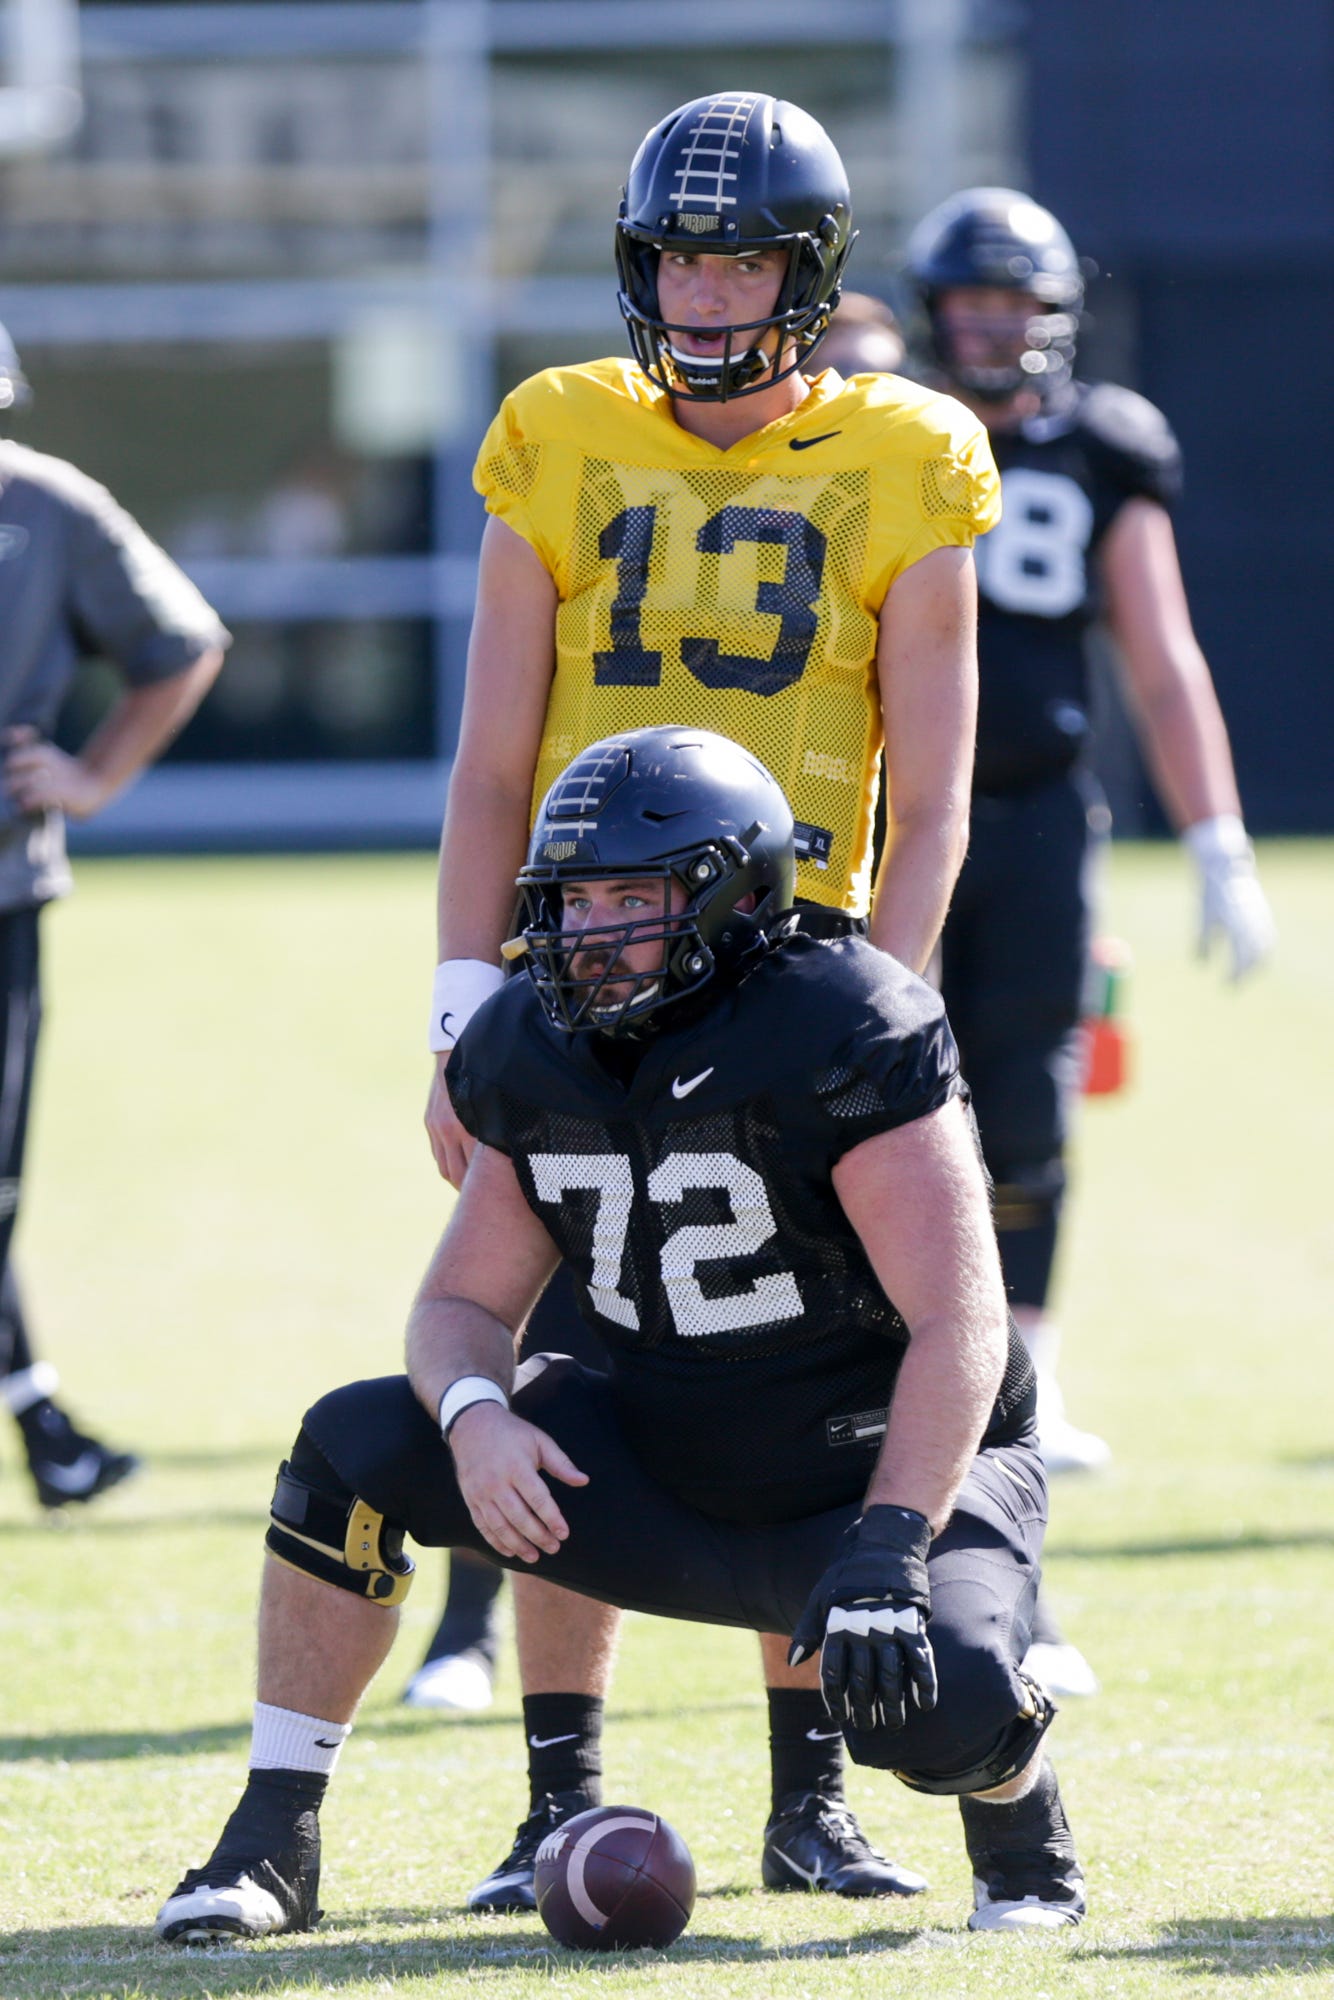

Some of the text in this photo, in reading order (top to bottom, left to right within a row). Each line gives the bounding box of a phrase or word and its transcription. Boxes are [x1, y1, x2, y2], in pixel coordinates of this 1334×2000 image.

[678, 213, 719, 234] PURDUE
[593, 505, 827, 697] 13
[543, 841, 576, 861] PURDUE
[815, 836, 825, 851] XL
[527, 1152, 805, 1337] 72
